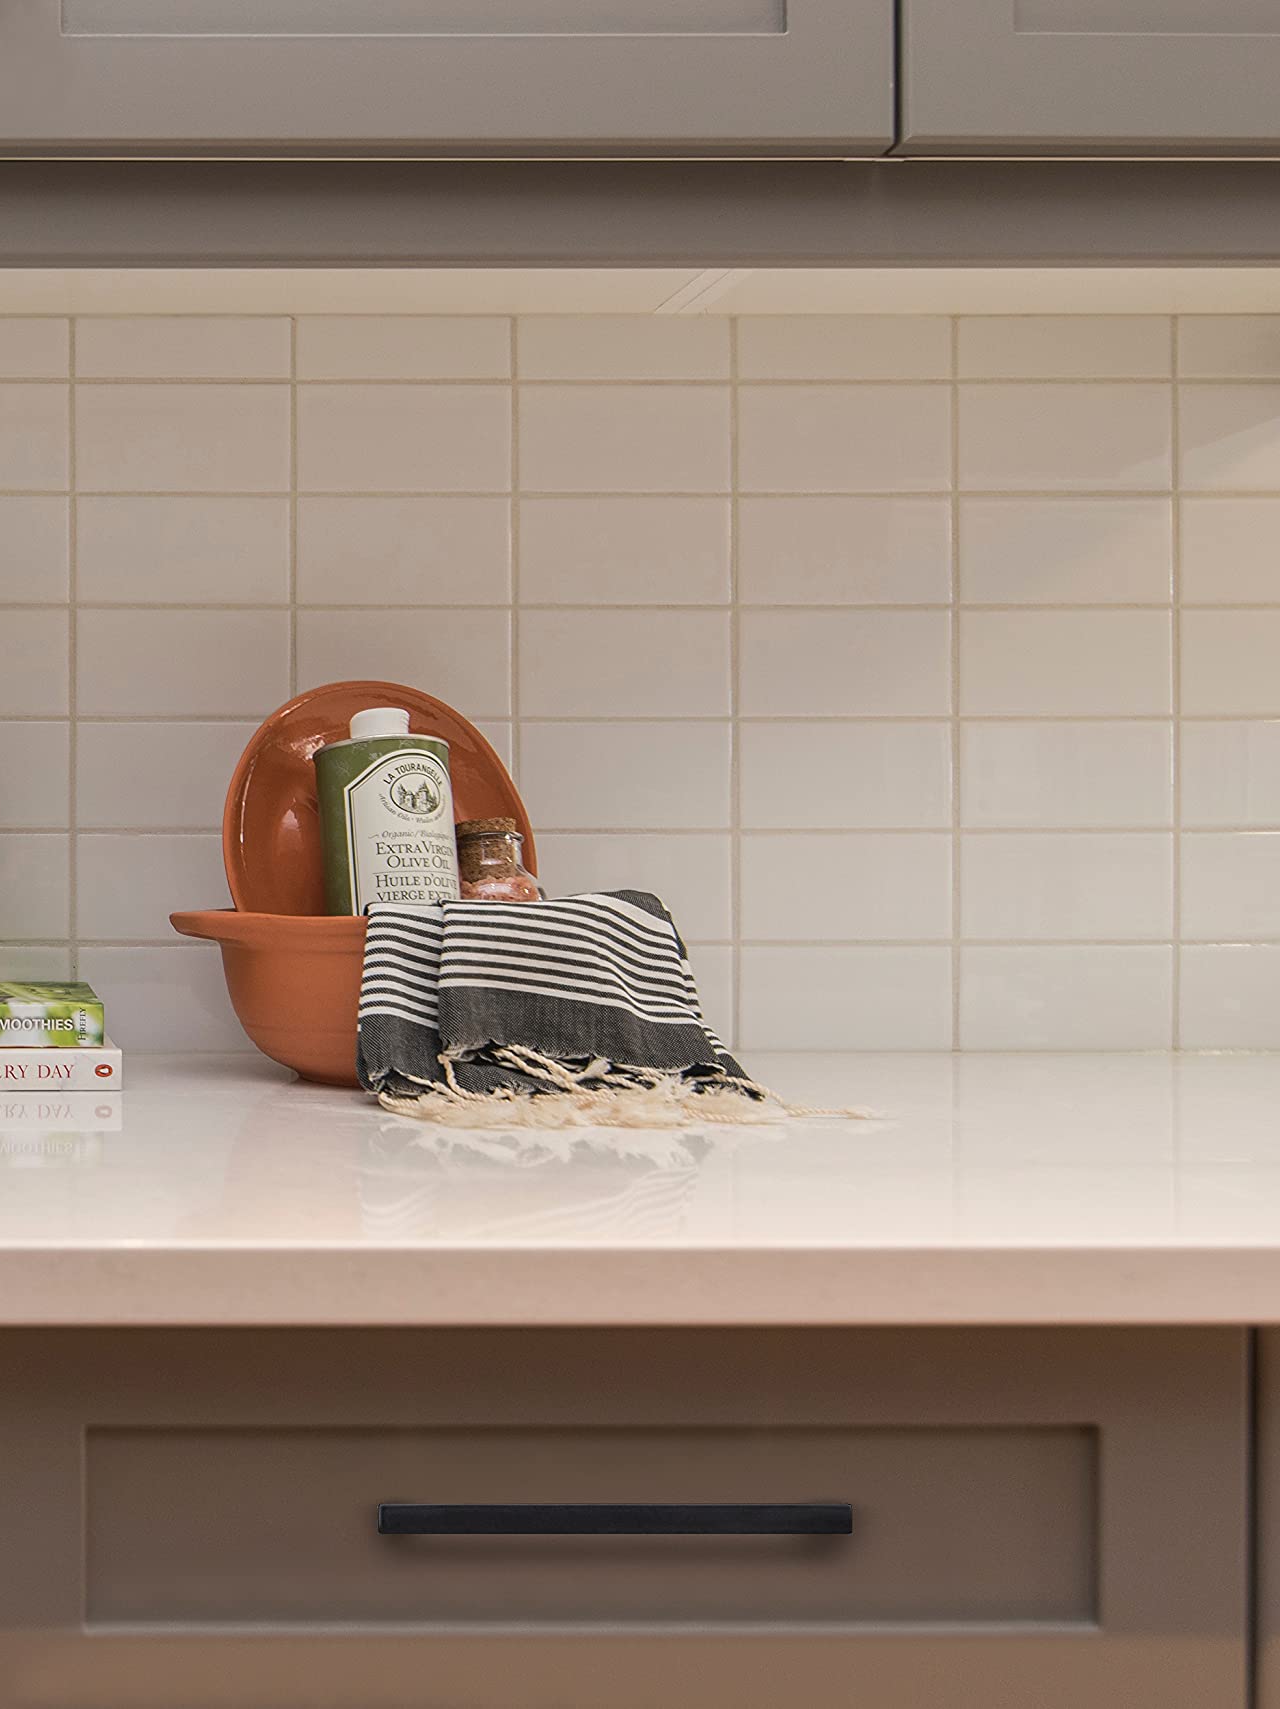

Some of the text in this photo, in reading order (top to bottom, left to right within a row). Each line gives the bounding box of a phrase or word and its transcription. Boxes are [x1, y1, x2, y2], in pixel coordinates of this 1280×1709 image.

[383, 773, 396, 785] LA
[376, 840, 454, 856] EXTRA VIRGIN
[387, 855, 451, 869] OLIVE OIL
[376, 874, 420, 888] HUILE
[376, 890, 426, 901] VIERGE
[38, 1064, 75, 1080] DAY
